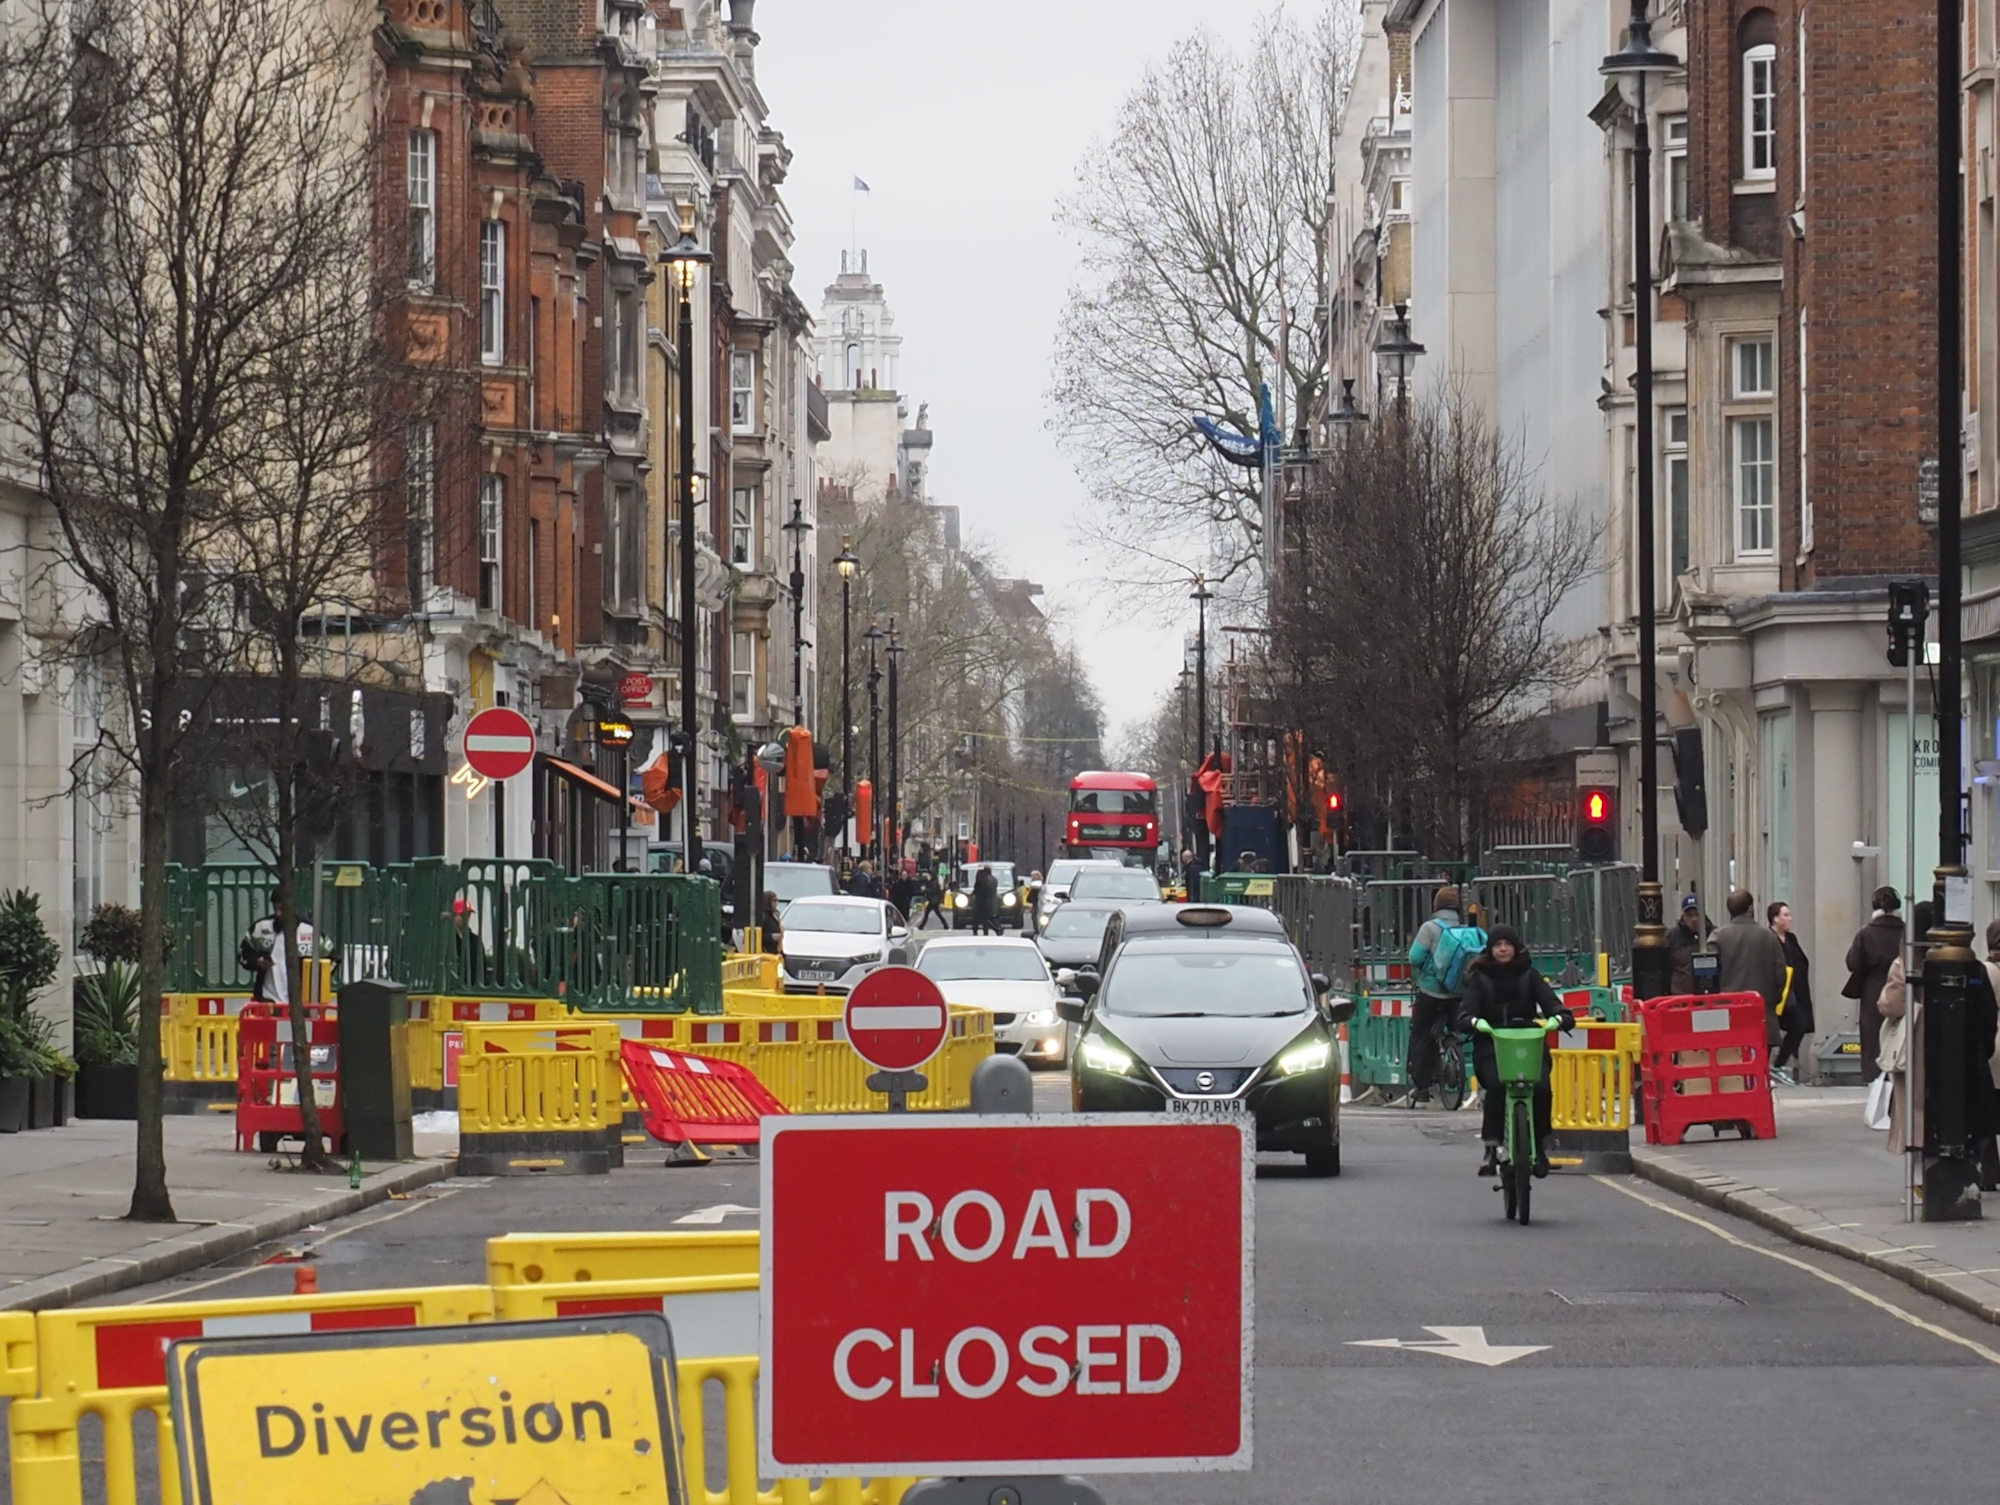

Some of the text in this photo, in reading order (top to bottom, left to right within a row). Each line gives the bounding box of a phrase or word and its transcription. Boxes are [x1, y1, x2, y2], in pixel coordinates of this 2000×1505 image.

[625, 677, 646, 686] POST
[620, 686, 650, 694] OFFICE
[1913, 739, 1941, 754] KRO
[1127, 826, 1142, 838] 55
[1173, 1100, 1209, 1113] BK70
[884, 1188, 1131, 1262] ROAD
[833, 1325, 1182, 1400] CLOSED
[255, 1391, 612, 1458] Diversion
